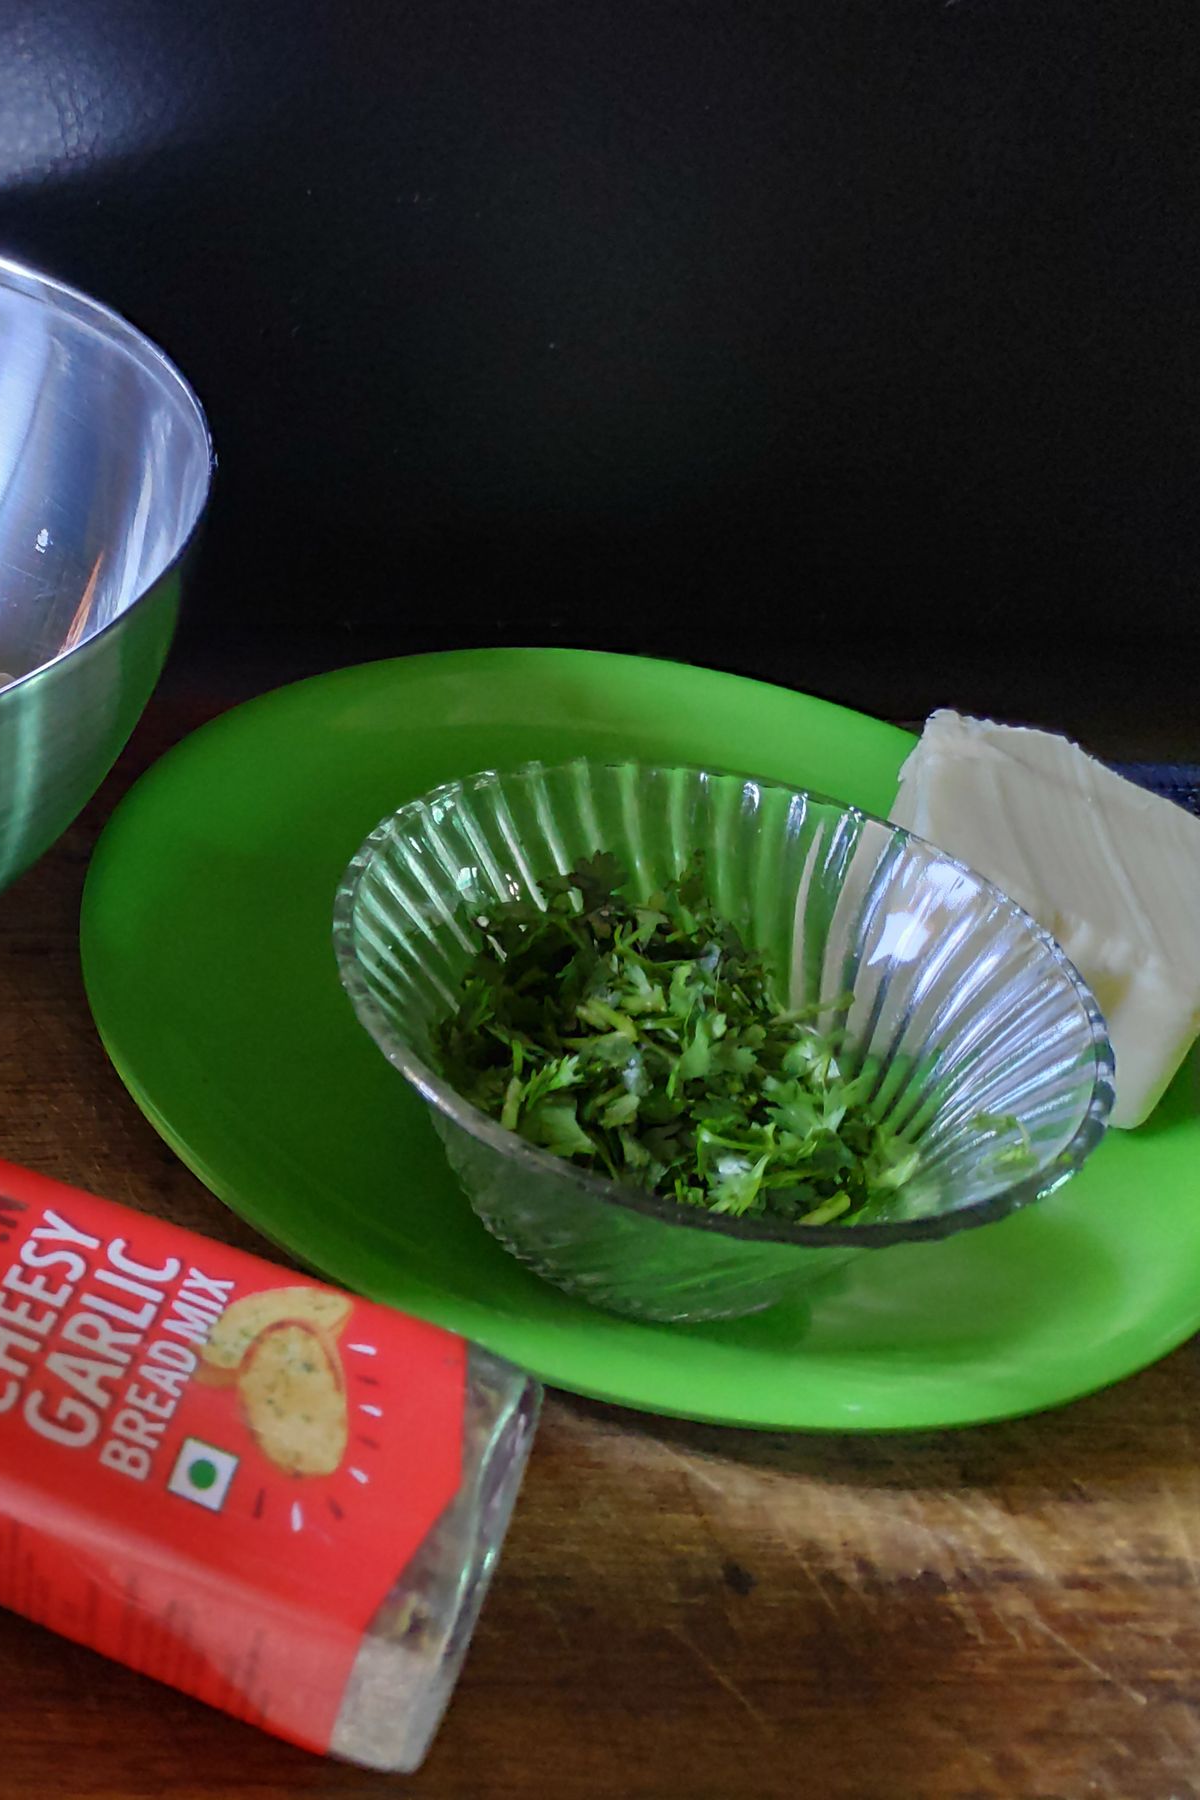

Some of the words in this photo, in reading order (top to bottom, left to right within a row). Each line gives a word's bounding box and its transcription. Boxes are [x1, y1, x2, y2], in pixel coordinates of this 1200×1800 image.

[24, 1238, 181, 1447] GARLIC
[99, 1340, 199, 1481] BREAD
[161, 1267, 235, 1345] MIX
